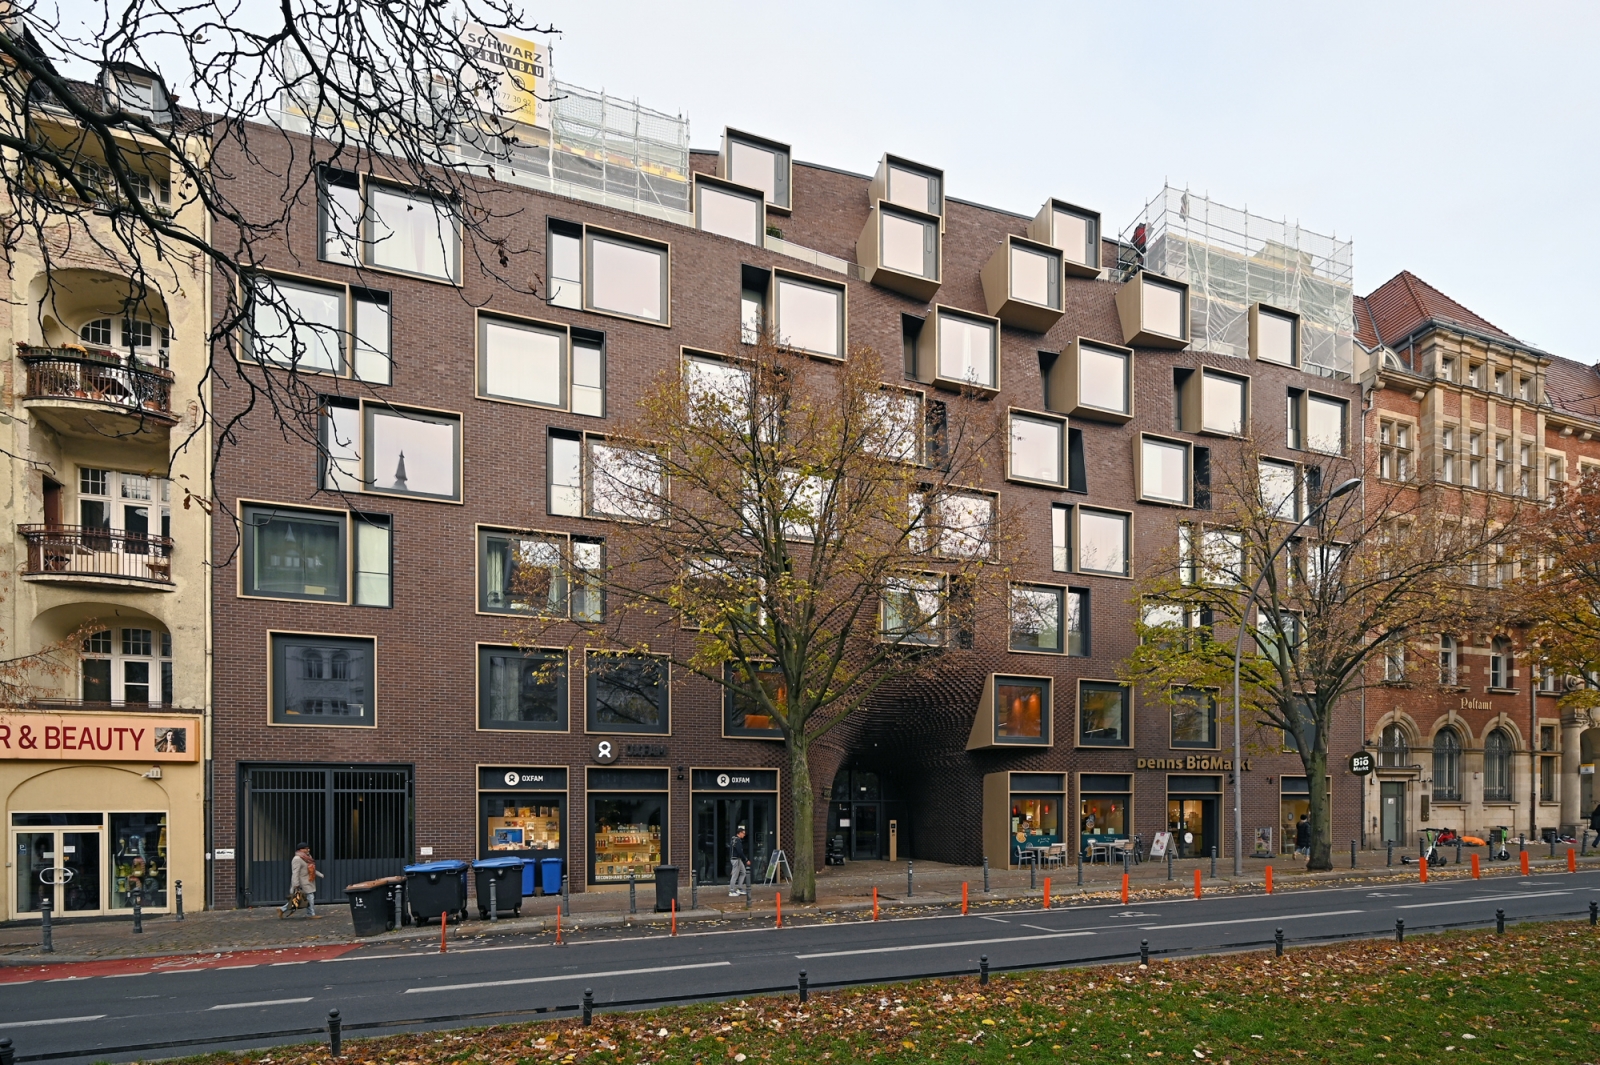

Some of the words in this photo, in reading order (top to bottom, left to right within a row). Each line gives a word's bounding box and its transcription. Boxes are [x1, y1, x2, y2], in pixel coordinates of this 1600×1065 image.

[467, 32, 543, 64] SCHWARZ
[502, 92, 511, 100] 77
[513, 94, 522, 103] 30
[0, 725, 11, 749] R
[18, 725, 38, 750] &
[45, 726, 145, 751] BEAUTY
[1186, 755, 1253, 771] BioMakt
